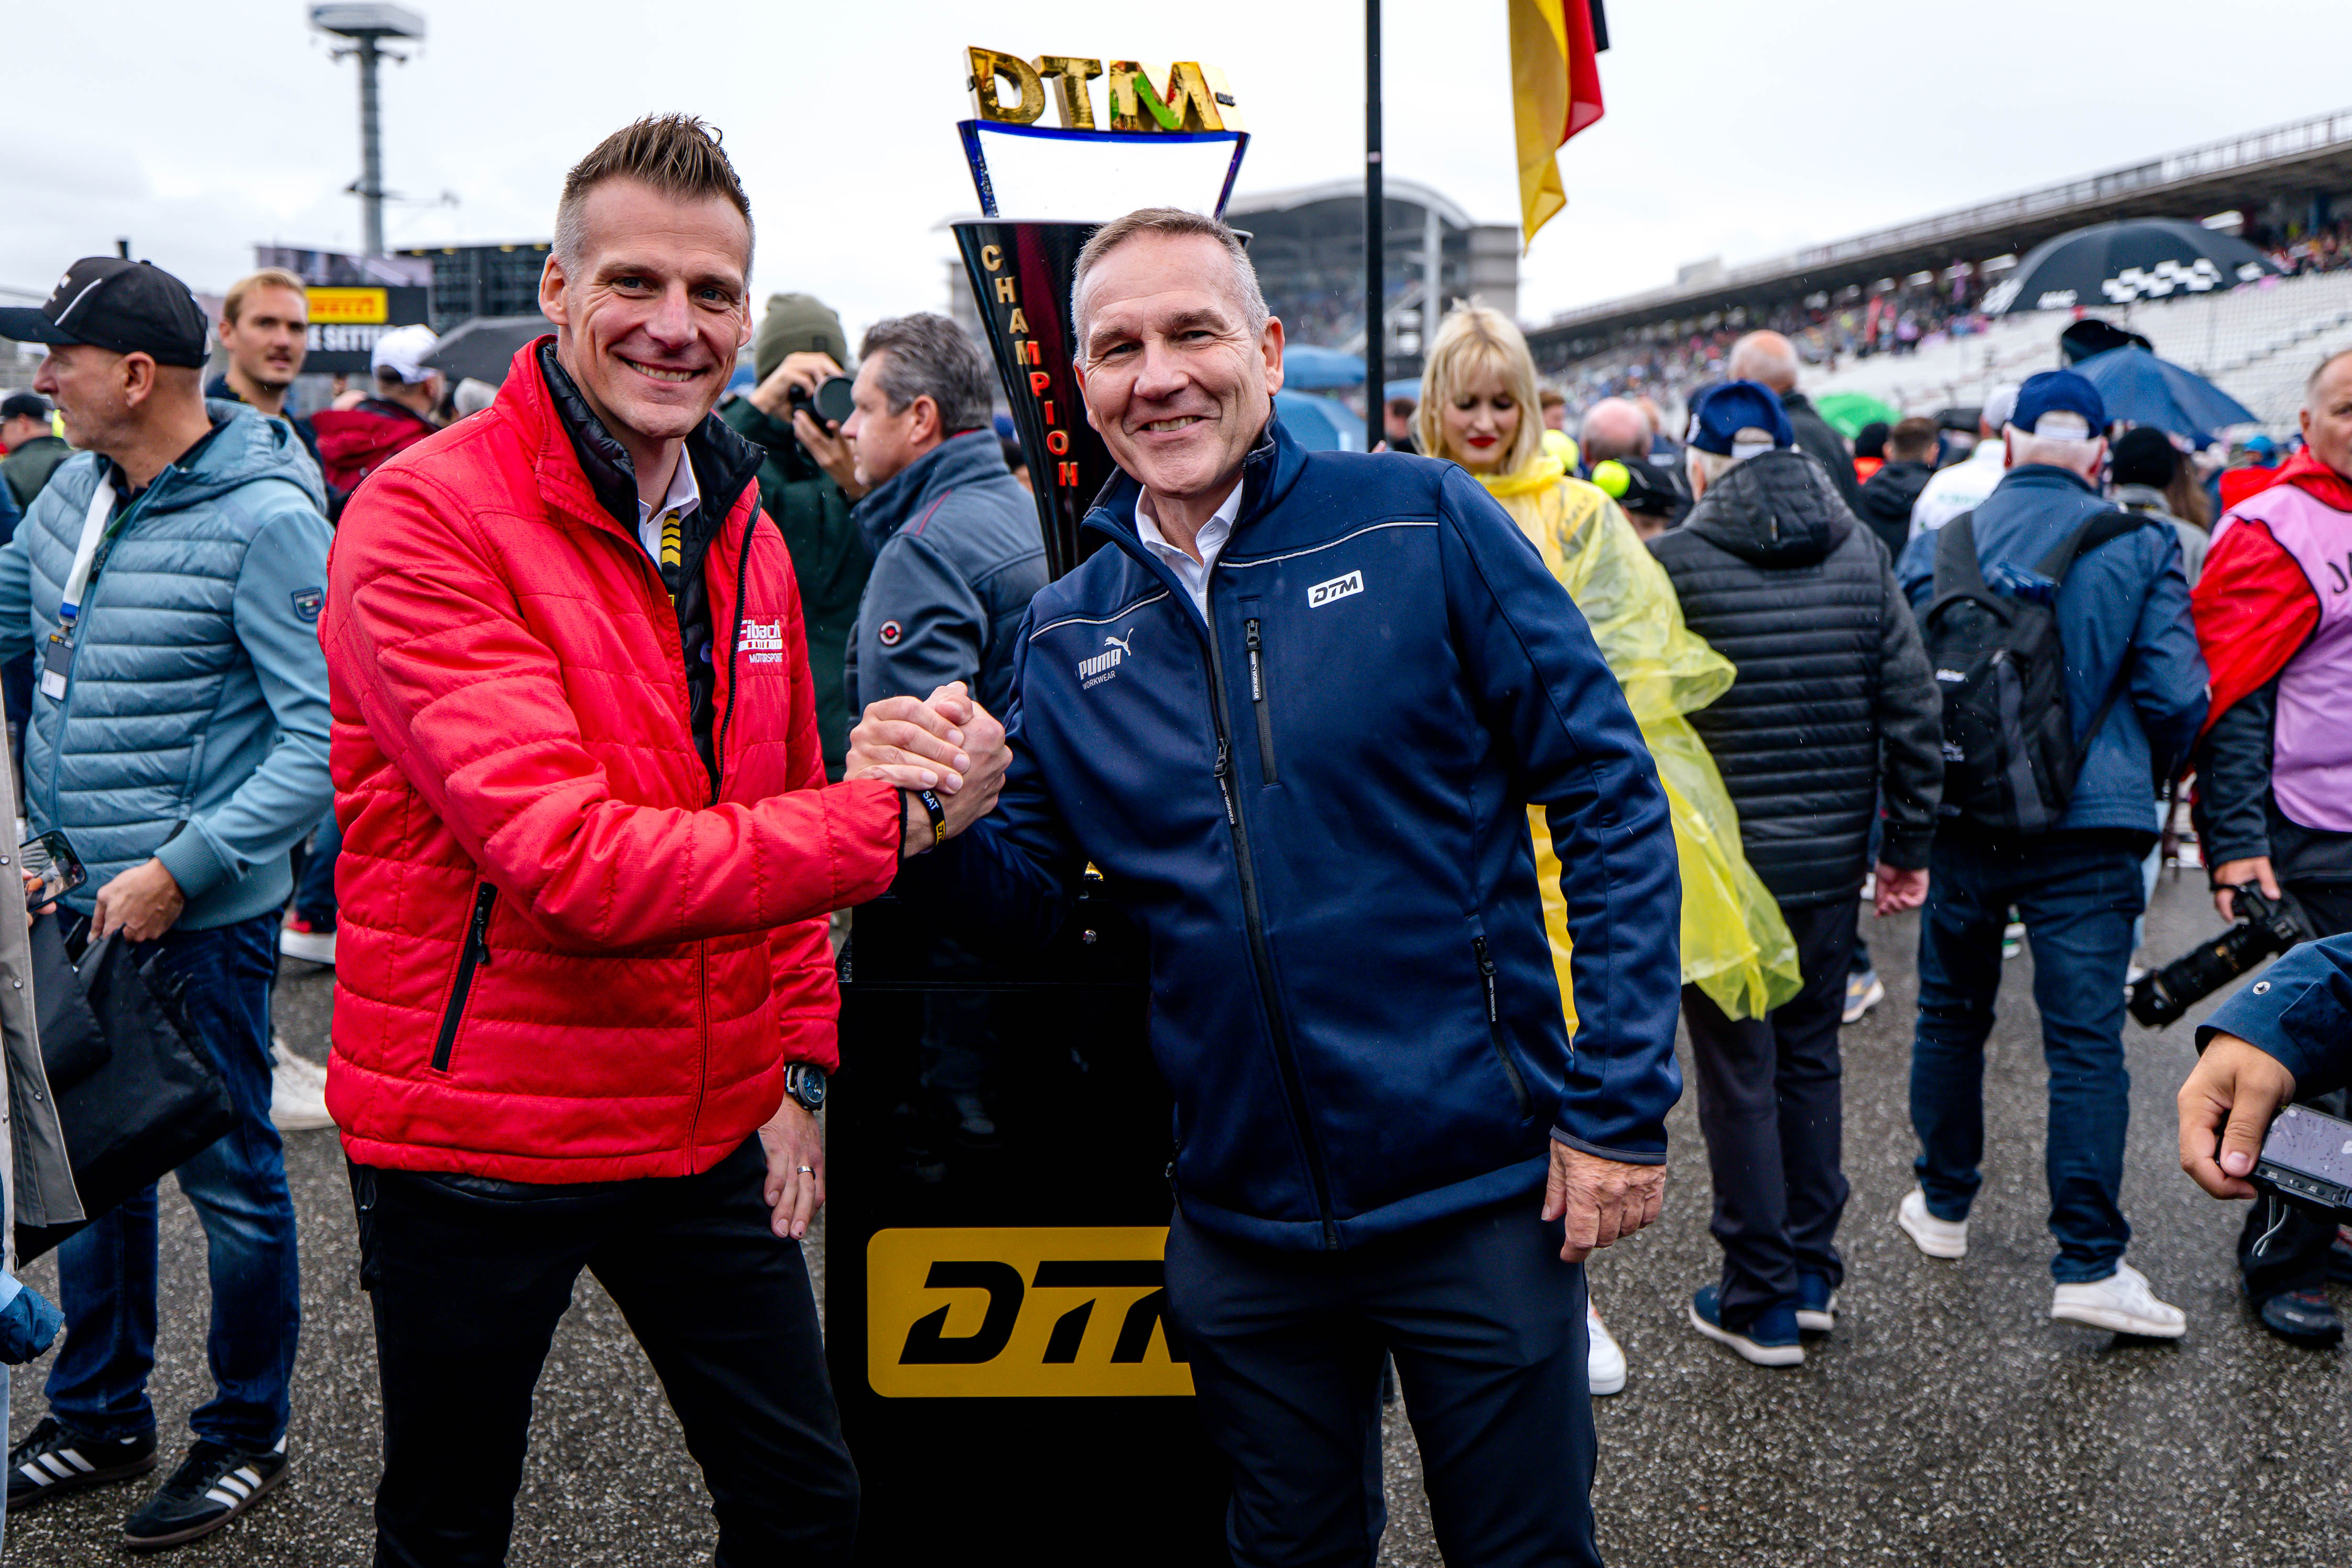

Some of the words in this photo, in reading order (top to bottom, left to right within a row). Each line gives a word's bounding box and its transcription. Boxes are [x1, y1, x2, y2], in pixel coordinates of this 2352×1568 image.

[964, 46, 1228, 131] DTM
[981, 244, 1079, 487] CHAMPION
[1313, 576, 1358, 603] DTM
[749, 652, 783, 663] MOTORSPORT
[1079, 648, 1121, 680] PUMA
[1082, 670, 1116, 690] WORKWEAR
[923, 790, 939, 810] SAT
[1224, 796, 1235, 824] WORKWEAR
